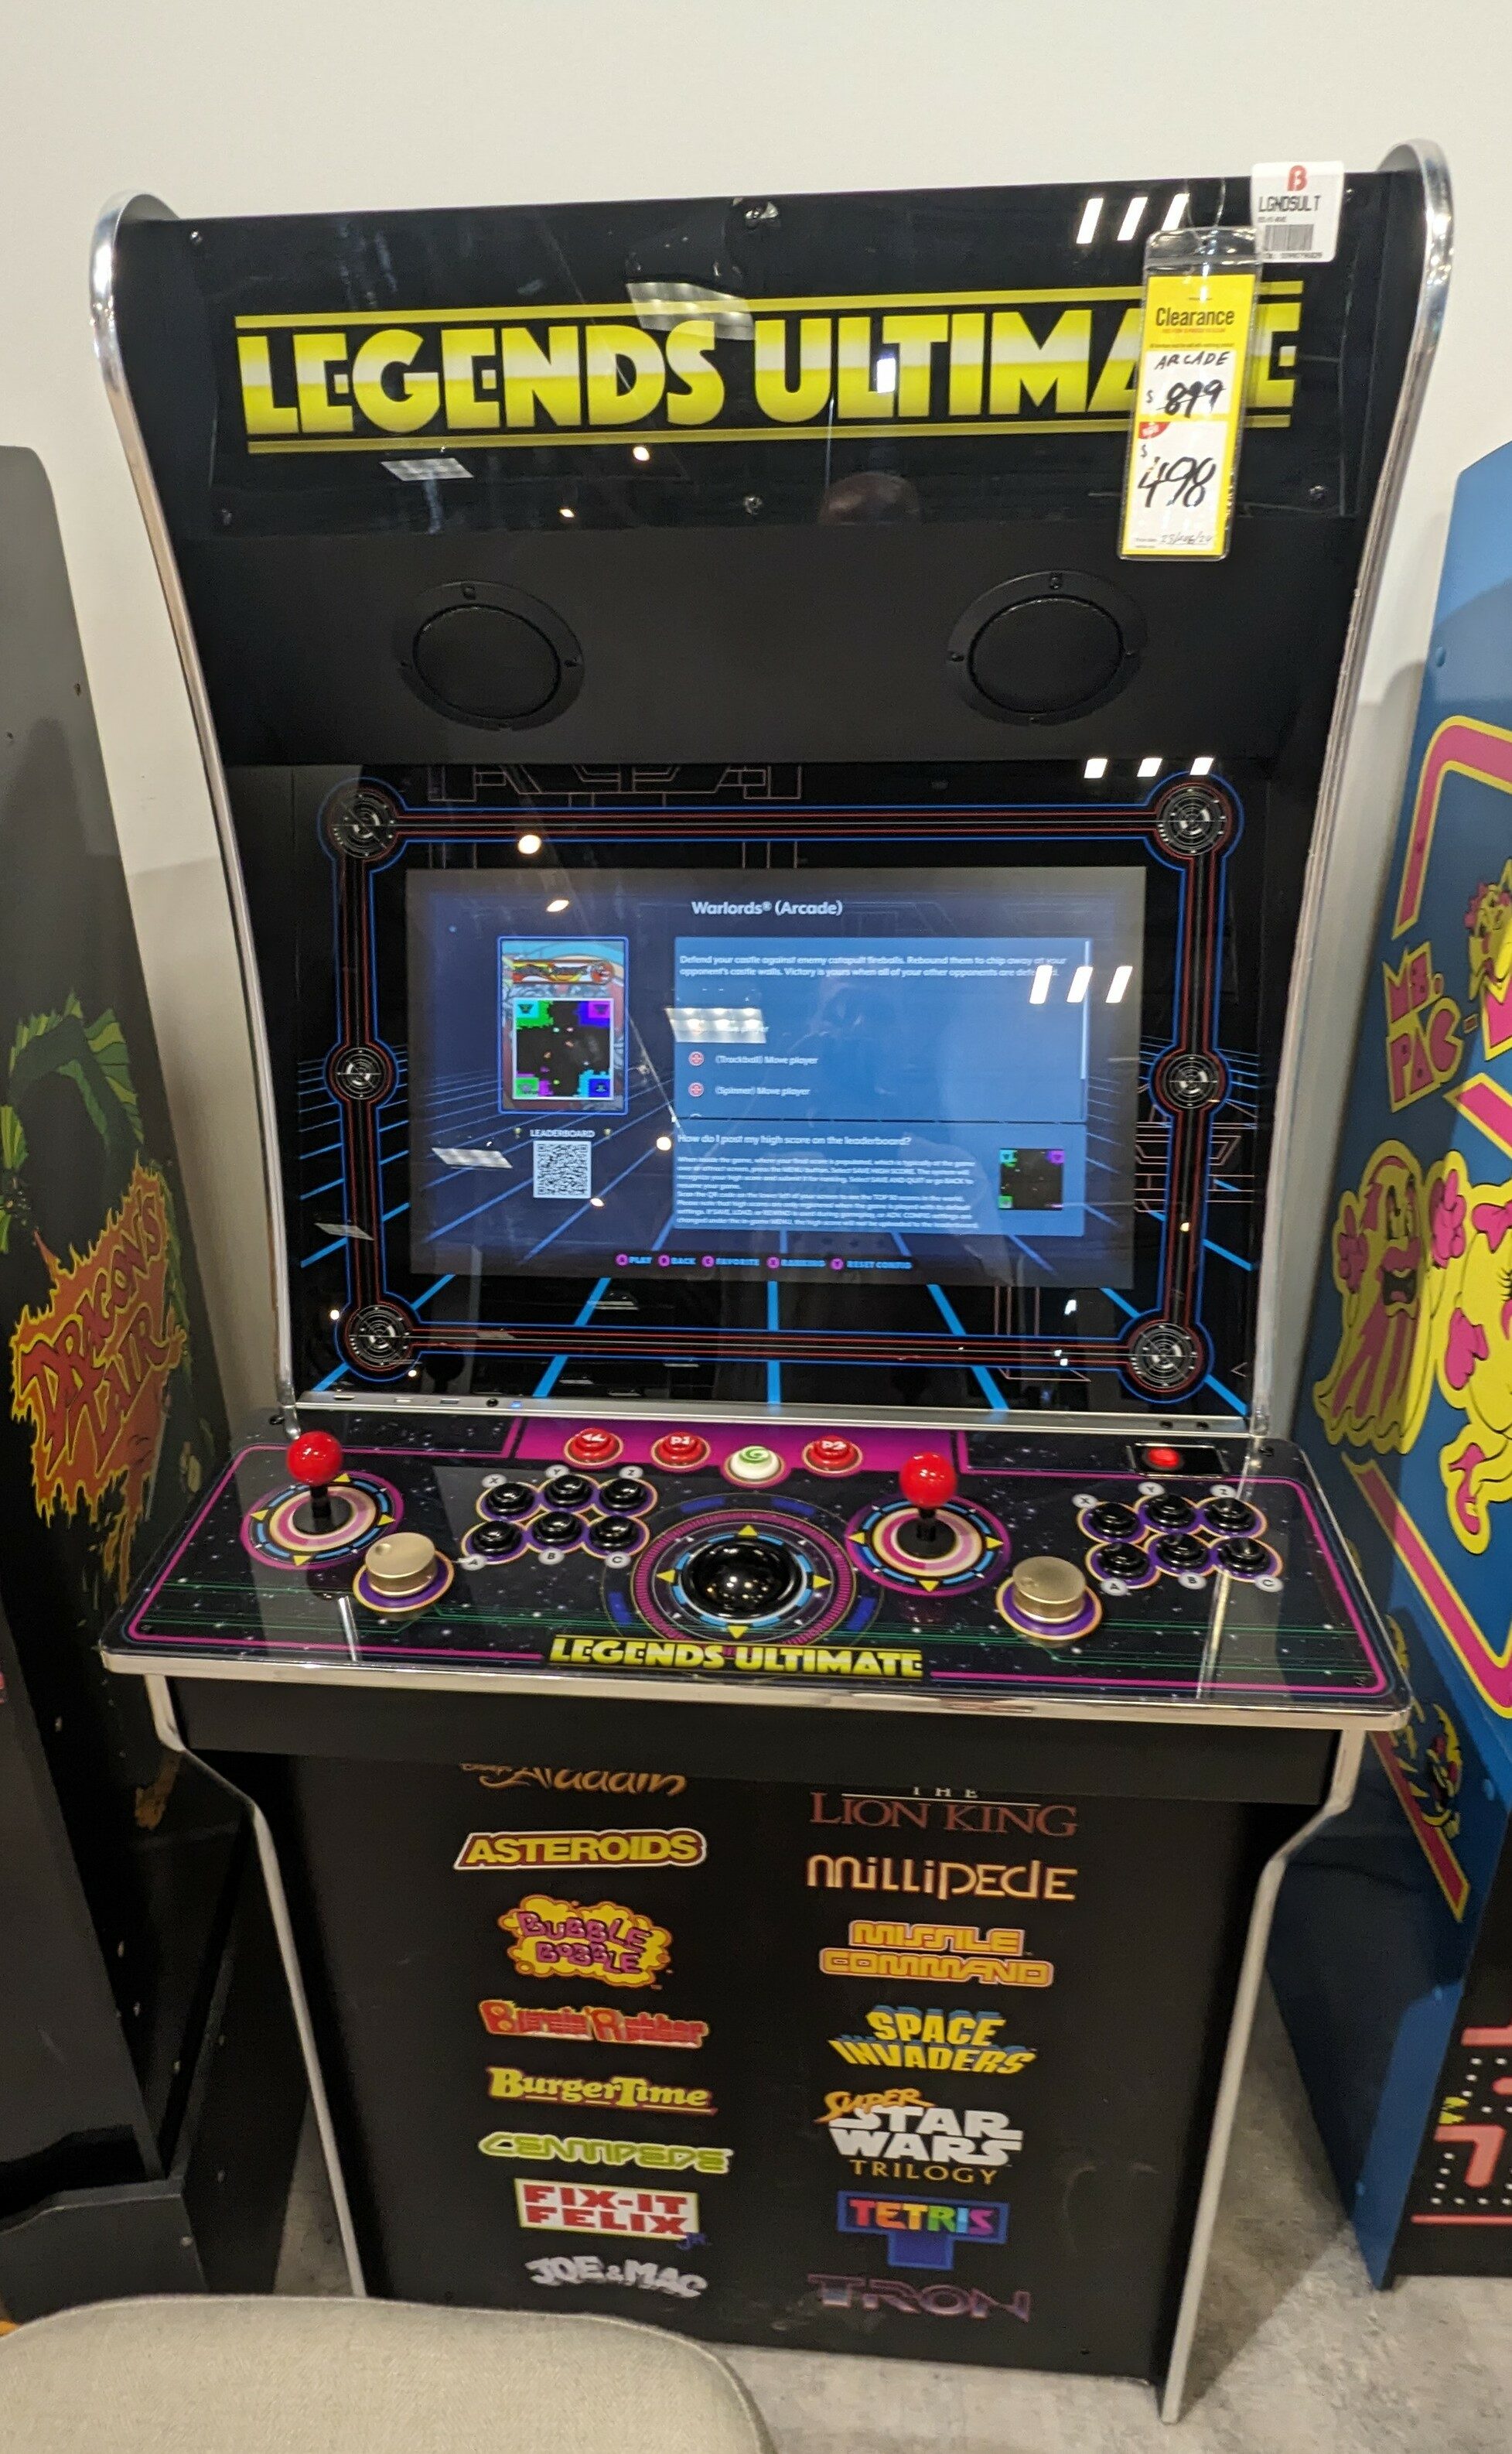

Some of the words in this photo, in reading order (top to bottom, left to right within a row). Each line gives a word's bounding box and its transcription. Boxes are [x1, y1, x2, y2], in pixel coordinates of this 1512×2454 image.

[1155, 307, 1236, 326] Clearance
[237, 320, 725, 436] LEGENDS
[754, 302, 1301, 423] ULTIME
[1155, 351, 1230, 370] ARCADE
[1163, 379, 1225, 419] 899
[1137, 456, 1217, 508] 498
[774, 901, 843, 917] (Arcade)
[713, 957, 733, 966] your
[797, 957, 827, 966] enemy
[906, 956, 948, 965] Rebound
[783, 969, 816, 977] Victory
[901, 969, 922, 978] your
[789, 1057, 818, 1065] player
[781, 1087, 811, 1097] player
[530, 1129, 596, 1138] LEADERBOARD
[721, 1136, 743, 1144] post
[760, 1135, 783, 1146] high
[549, 1638, 725, 1671] LEGENDS
[731, 1645, 923, 1678] ULTIMATE
[811, 1792, 929, 1829] LION
[944, 1803, 1078, 1837] KING
[465, 1834, 698, 1864] ASTEROIDS
[517, 1910, 654, 1953] BUBBLE
[851, 1921, 1023, 1956] MISSILE
[535, 1941, 643, 1974] BOBBLE
[821, 1949, 1053, 1987] COMMAND
[865, 2006, 1006, 2047] SPACE
[828, 2038, 1037, 2074] INVADERS
[489, 2067, 709, 2108] BurgerTime
[829, 2105, 1023, 2141] STAR
[479, 2132, 733, 2173] CENTIPEDE
[829, 2128, 1022, 2166] WARS
[850, 2159, 998, 2186] TRILOGY
[524, 2184, 688, 2215] FIX-IT
[849, 2199, 995, 2235] TETRIS
[525, 2205, 688, 2236] FELIX
[525, 2255, 605, 2286] JOE
[624, 2258, 708, 2298] MAC
[807, 2273, 1032, 2322] TRON
